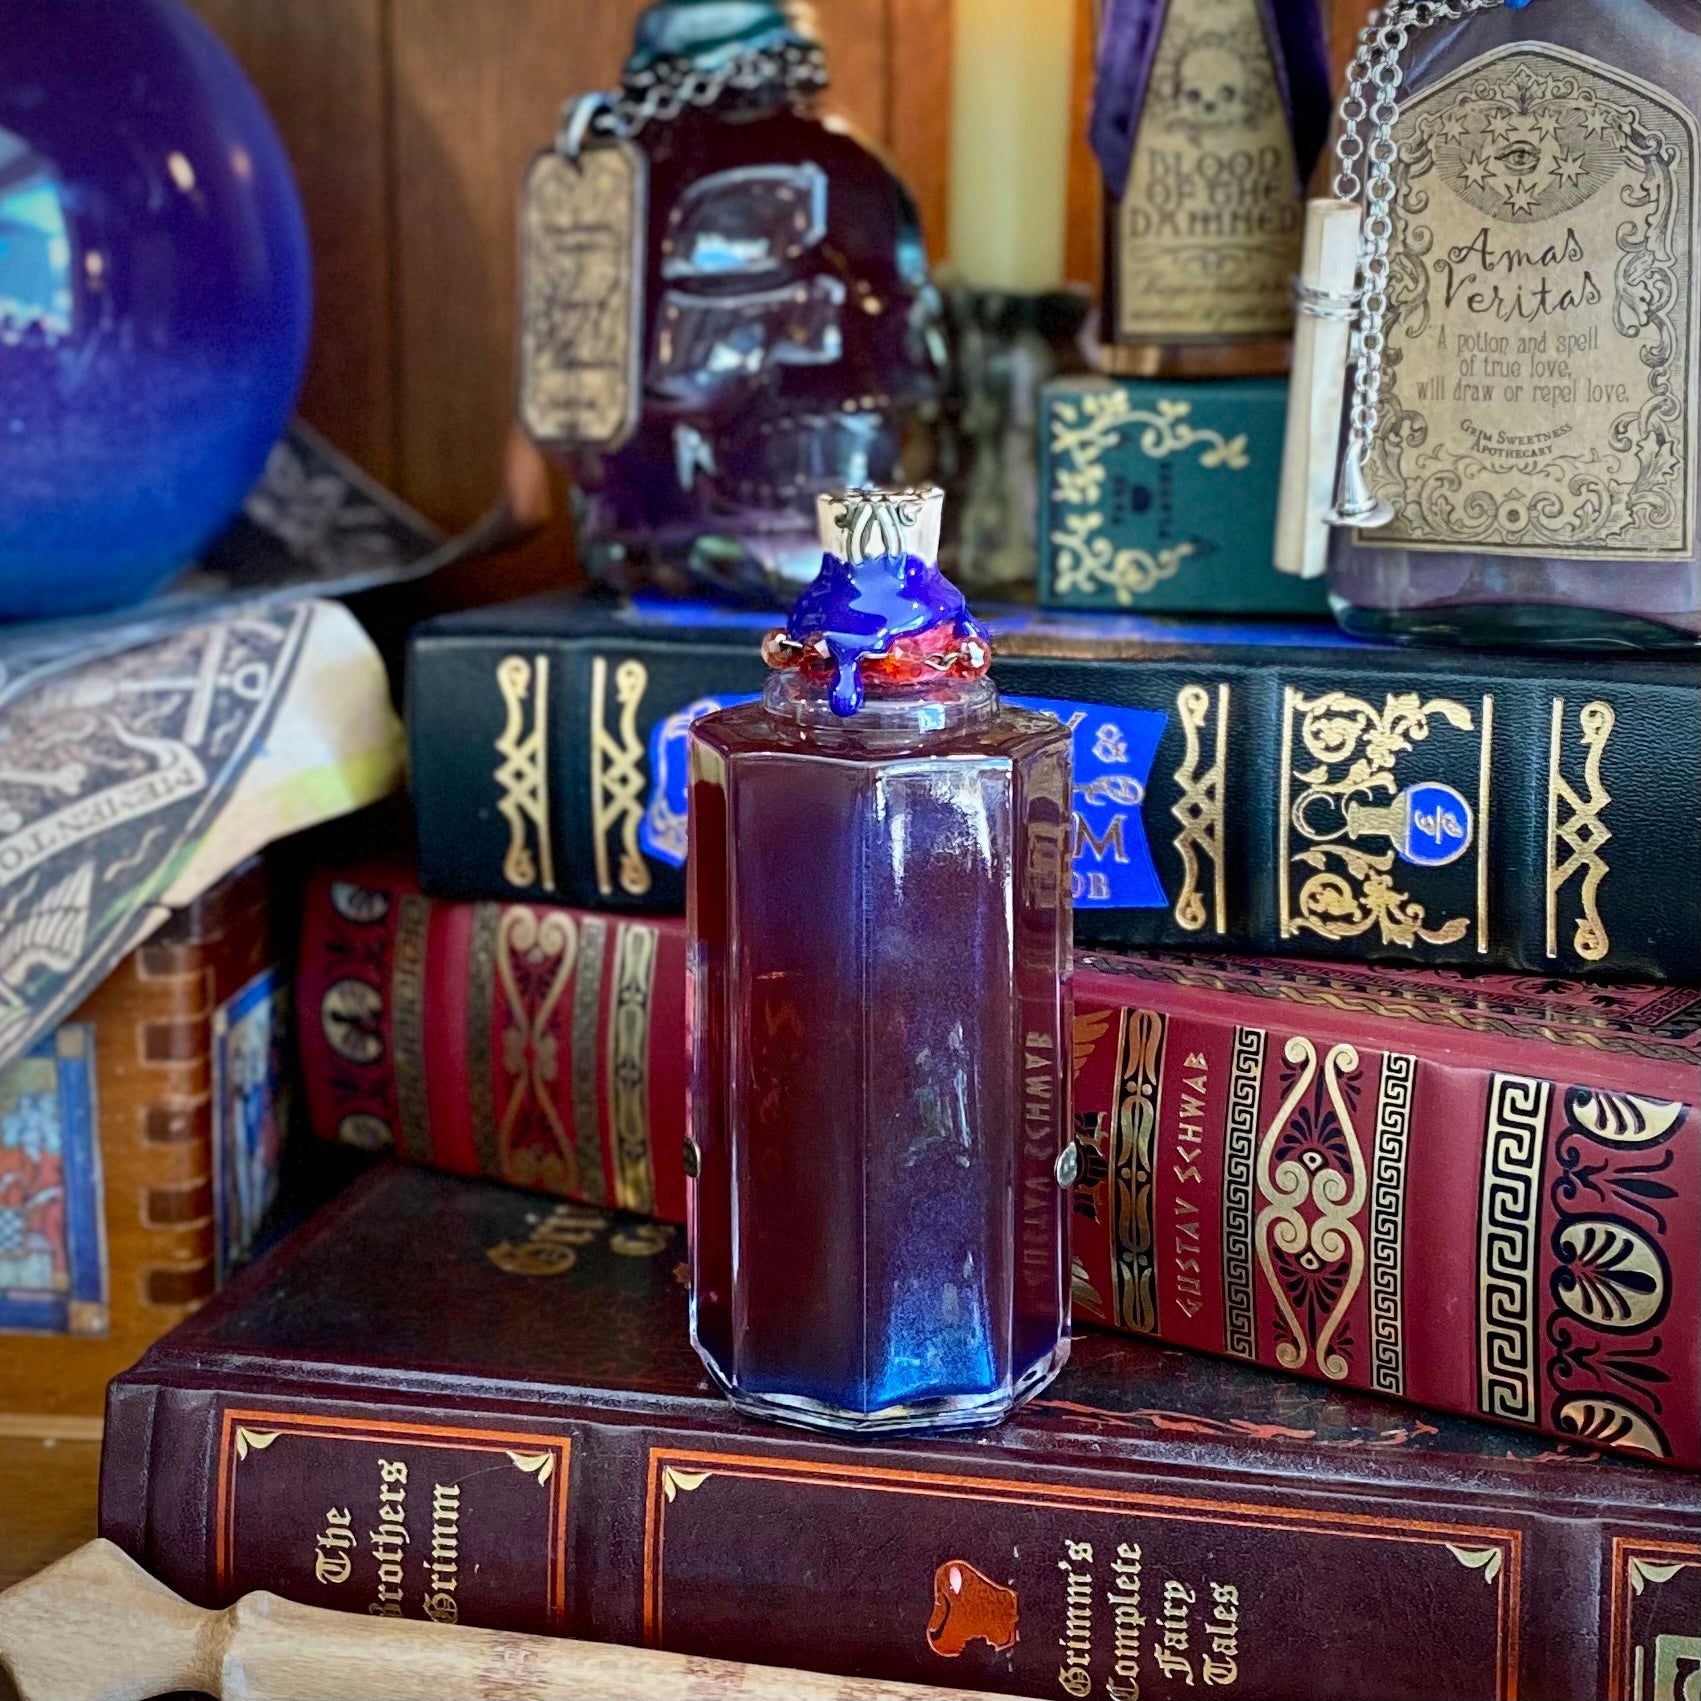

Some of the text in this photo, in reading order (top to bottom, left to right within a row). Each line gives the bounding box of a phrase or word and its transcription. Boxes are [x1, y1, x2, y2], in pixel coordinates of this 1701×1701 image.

[1149, 147, 1283, 180] BLOOD
[1448, 227, 1583, 273] Amas
[1434, 259, 1600, 321] Veritas
[1437, 325, 1599, 357] A potion and spell
[1459, 354, 1476, 377] of
[1484, 356, 1521, 378] true
[1417, 376, 1445, 401] will
[1453, 378, 1495, 401] draw
[1504, 385, 1523, 402] or
[1532, 378, 1577, 407] repel
[1173, 1051, 1210, 1318] GUSTAV SCHWAB
[314, 1506, 357, 1584] The
[422, 1482, 461, 1625] Grimm
[1058, 1539, 1094, 1698] Grimm's
[1153, 1580, 1197, 1687] Fairy
[1202, 1582, 1240, 1686] Tales
